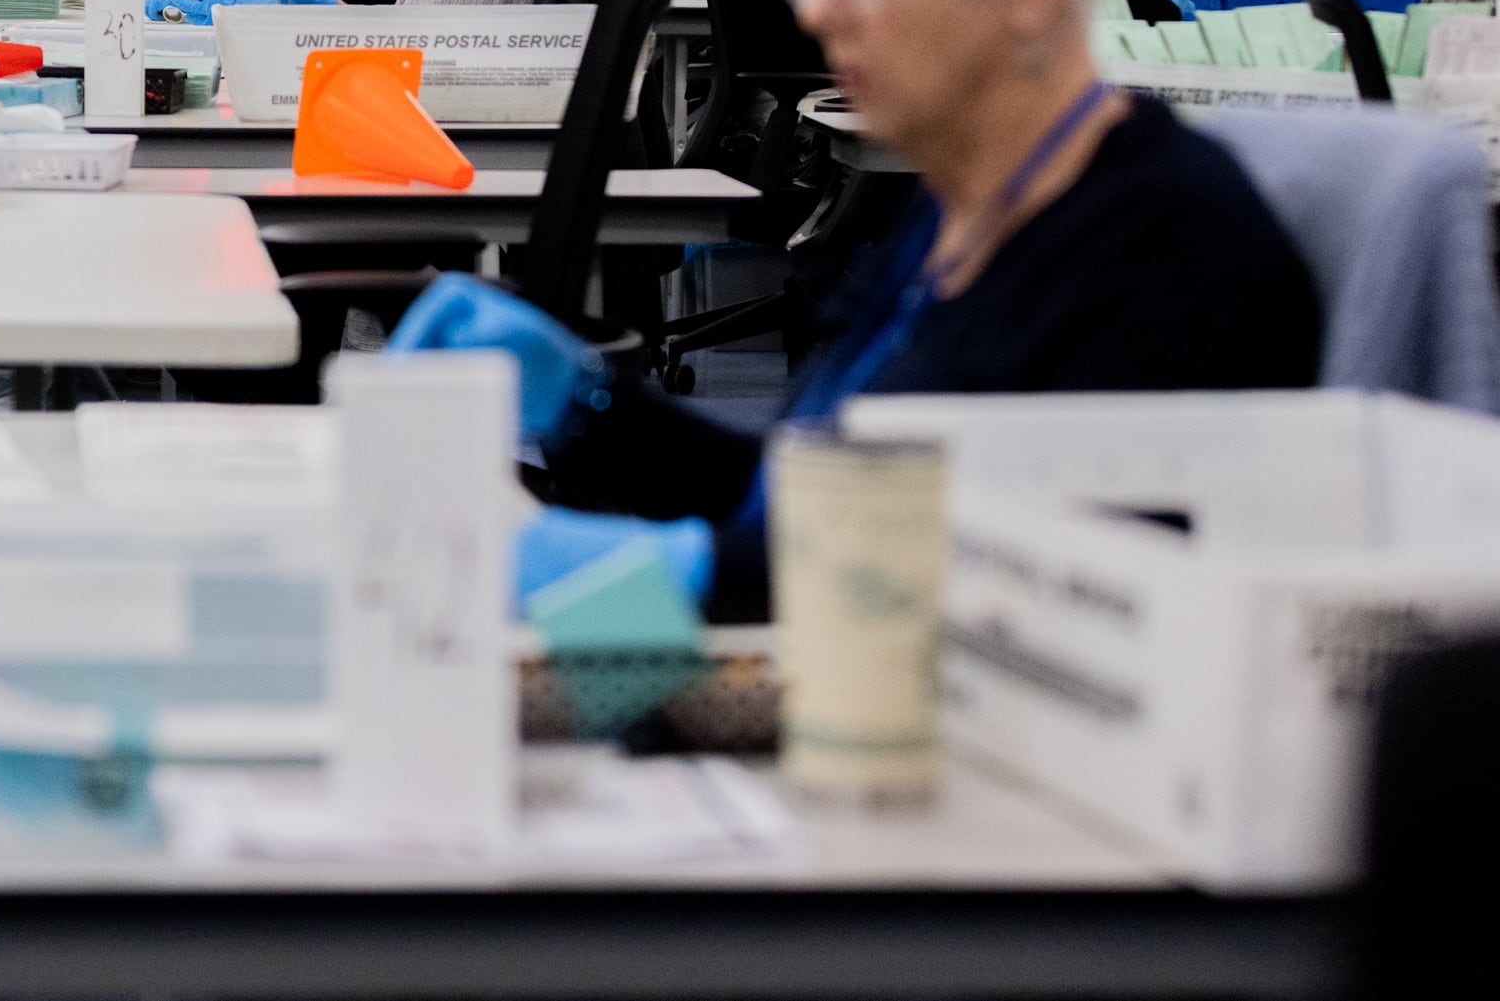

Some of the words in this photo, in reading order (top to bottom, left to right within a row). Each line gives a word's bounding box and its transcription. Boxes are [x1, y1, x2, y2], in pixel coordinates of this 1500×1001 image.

[295, 34, 359, 49] UNITED
[364, 34, 429, 49] STATES
[434, 34, 502, 49] POSTAL
[506, 34, 584, 49] SERVICE
